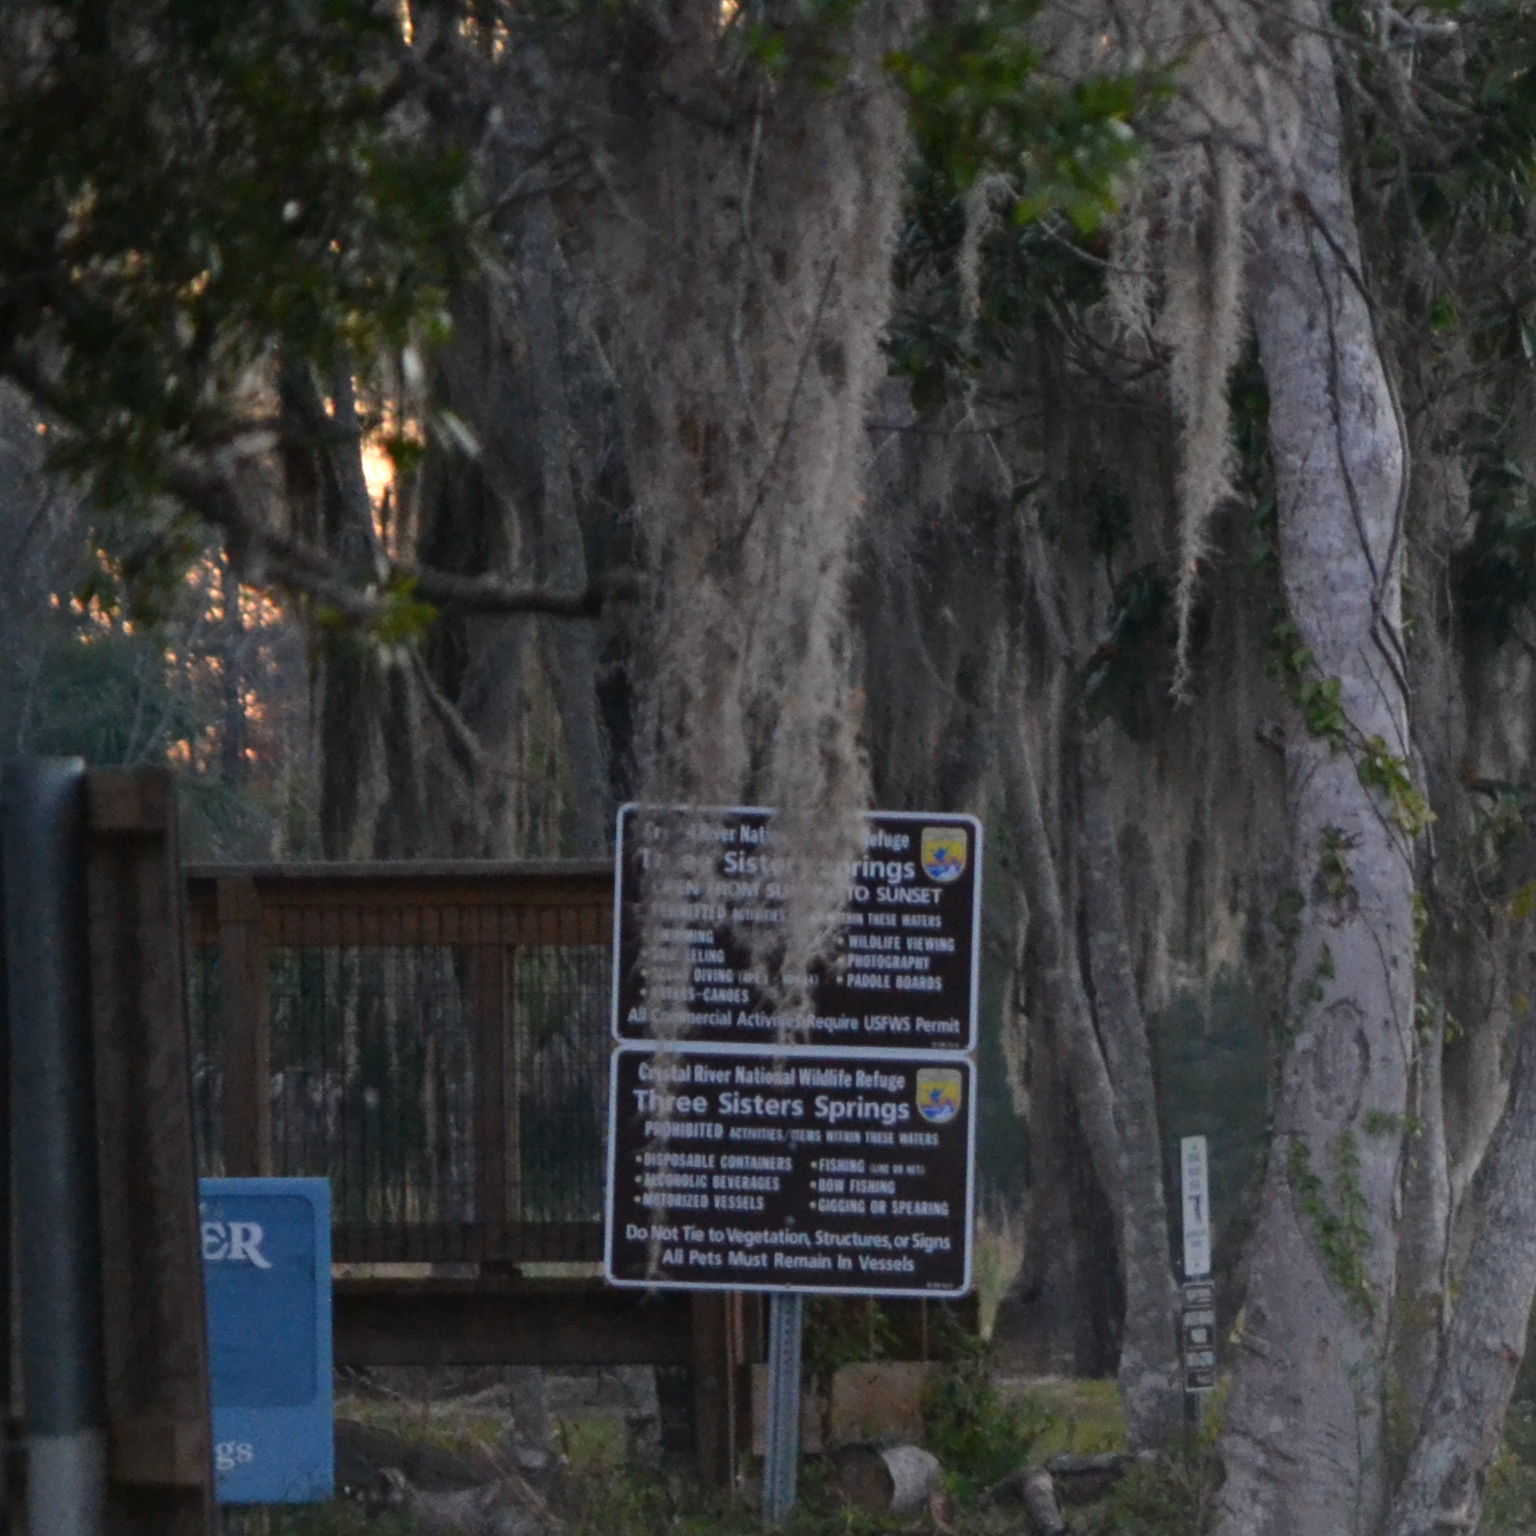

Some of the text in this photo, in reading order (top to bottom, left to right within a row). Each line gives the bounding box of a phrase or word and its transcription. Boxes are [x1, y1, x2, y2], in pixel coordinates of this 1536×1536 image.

[876, 886, 943, 905] SUNSET
[868, 912, 897, 928] THESE
[902, 913, 942, 929] WATERS
[849, 934, 955, 953] WILDLIFE VIEWING
[848, 953, 930, 971] PHOTOGRAPHY
[694, 968, 735, 984] DIVING
[847, 972, 943, 992] PADDLE BOARDS
[628, 1007, 647, 1024] All
[807, 1014, 858, 1034] Require
[864, 1016, 910, 1033] USFWS
[916, 1018, 960, 1034] Permit
[694, 1064, 732, 1083] River
[735, 1065, 796, 1086] National
[799, 1067, 852, 1088] Wildlife
[855, 1069, 906, 1093] Refuge
[633, 1089, 910, 1126] Three Sisters Springs
[644, 1120, 724, 1139] PROHIBITED
[643, 1153, 793, 1172] DISPOSABLE CONTAINERS
[818, 1158, 865, 1174] FISHING
[643, 1173, 781, 1192] ALCOHOLIC BEVERAGES
[818, 1178, 896, 1195] BOW FISHING
[642, 1193, 765, 1212] MOTORIZED VESSELS
[818, 1199, 866, 1215] GIGGING
[891, 1201, 950, 1217] SPEARING
[625, 1223, 951, 1254] Do Not Tie to Vegetation, Structures, or Signs
[662, 1248, 915, 1273] All Pets Must Remain In Vessels
